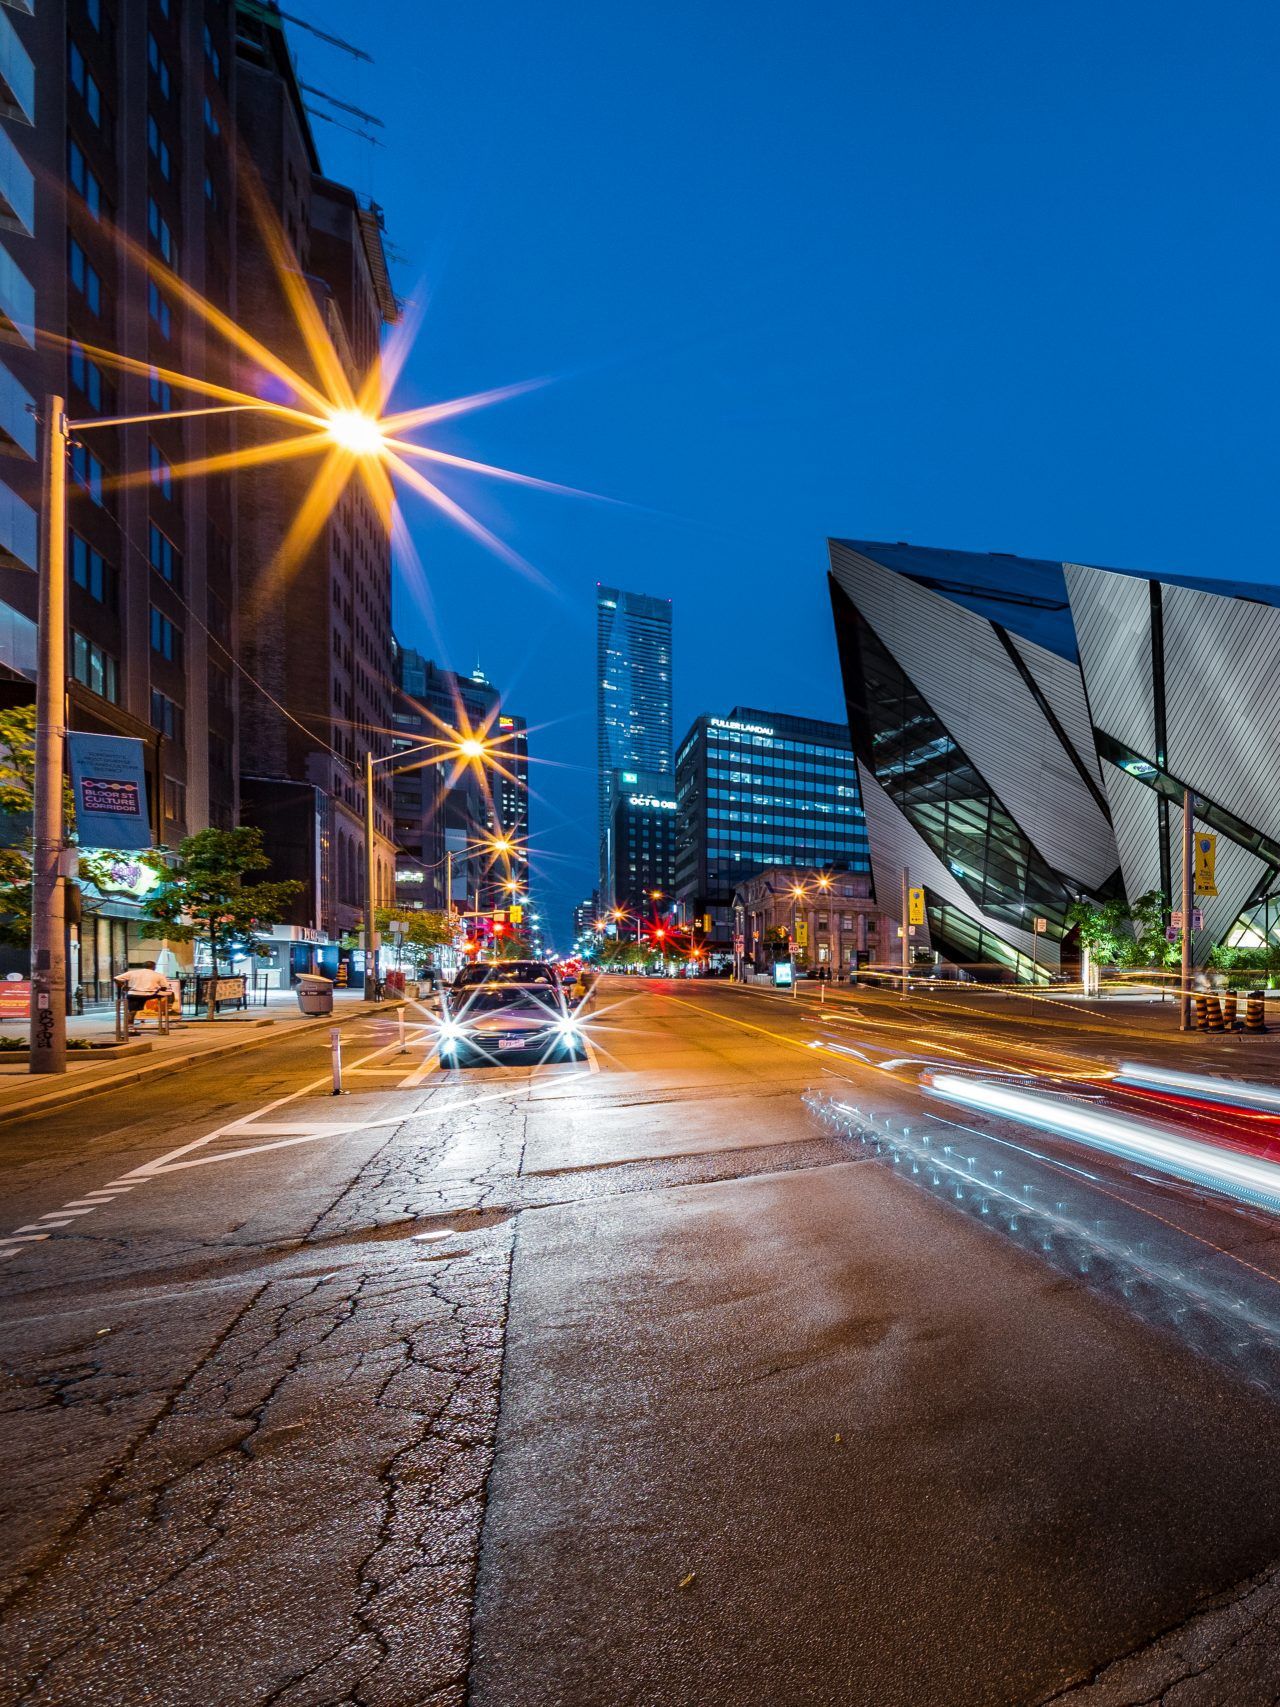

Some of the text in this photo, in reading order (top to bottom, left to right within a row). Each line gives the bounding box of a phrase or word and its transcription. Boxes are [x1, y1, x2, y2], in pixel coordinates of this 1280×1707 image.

[711, 718, 774, 735] FULLER LANDAU
[85, 790, 119, 798] BLOOR
[85, 796, 135, 805] CULTURE
[85, 803, 136, 812] CORRIDOR
